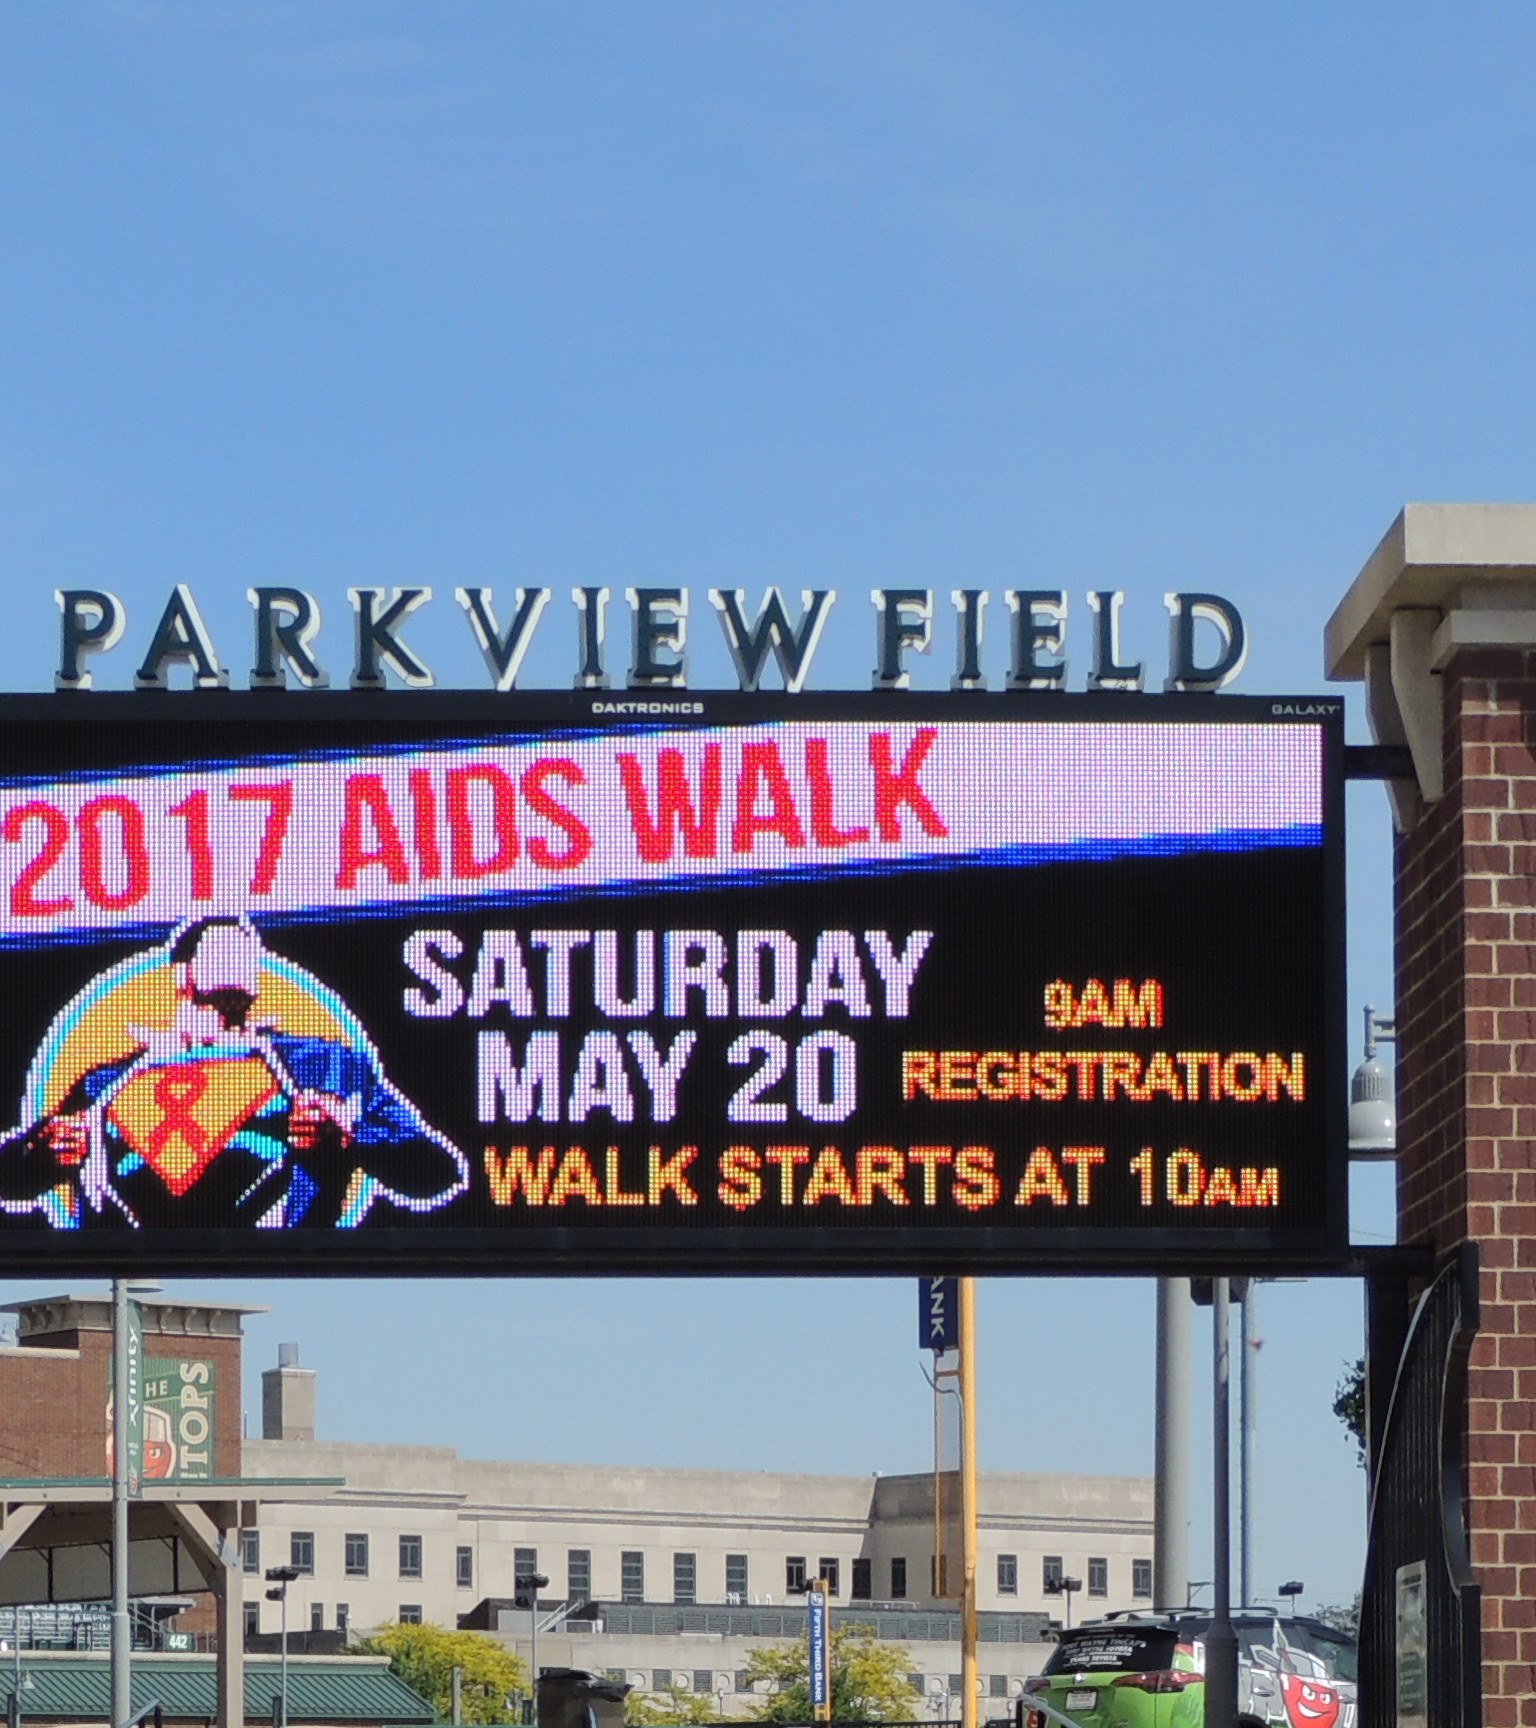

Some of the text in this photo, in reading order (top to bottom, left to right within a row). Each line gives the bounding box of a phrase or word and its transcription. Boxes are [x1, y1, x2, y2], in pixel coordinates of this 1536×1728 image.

[55, 584, 1249, 692] PARKVIEW FIELD
[591, 702, 704, 714] DAKTRONICS
[1271, 704, 1337, 715] GALAXY
[0, 726, 949, 917] 2017 AIDS WALK
[402, 929, 935, 1019] SATURDAY
[1043, 977, 1165, 1030] 9AM
[477, 1029, 858, 1123] MAY 20
[901, 1050, 1307, 1101] REGISTRATION
[483, 1145, 1280, 1212] WALK STARTS AT 10AM
[930, 1277, 945, 1339] ANK
[145, 1379, 169, 1398] HE
[169, 1634, 188, 1649] 442
